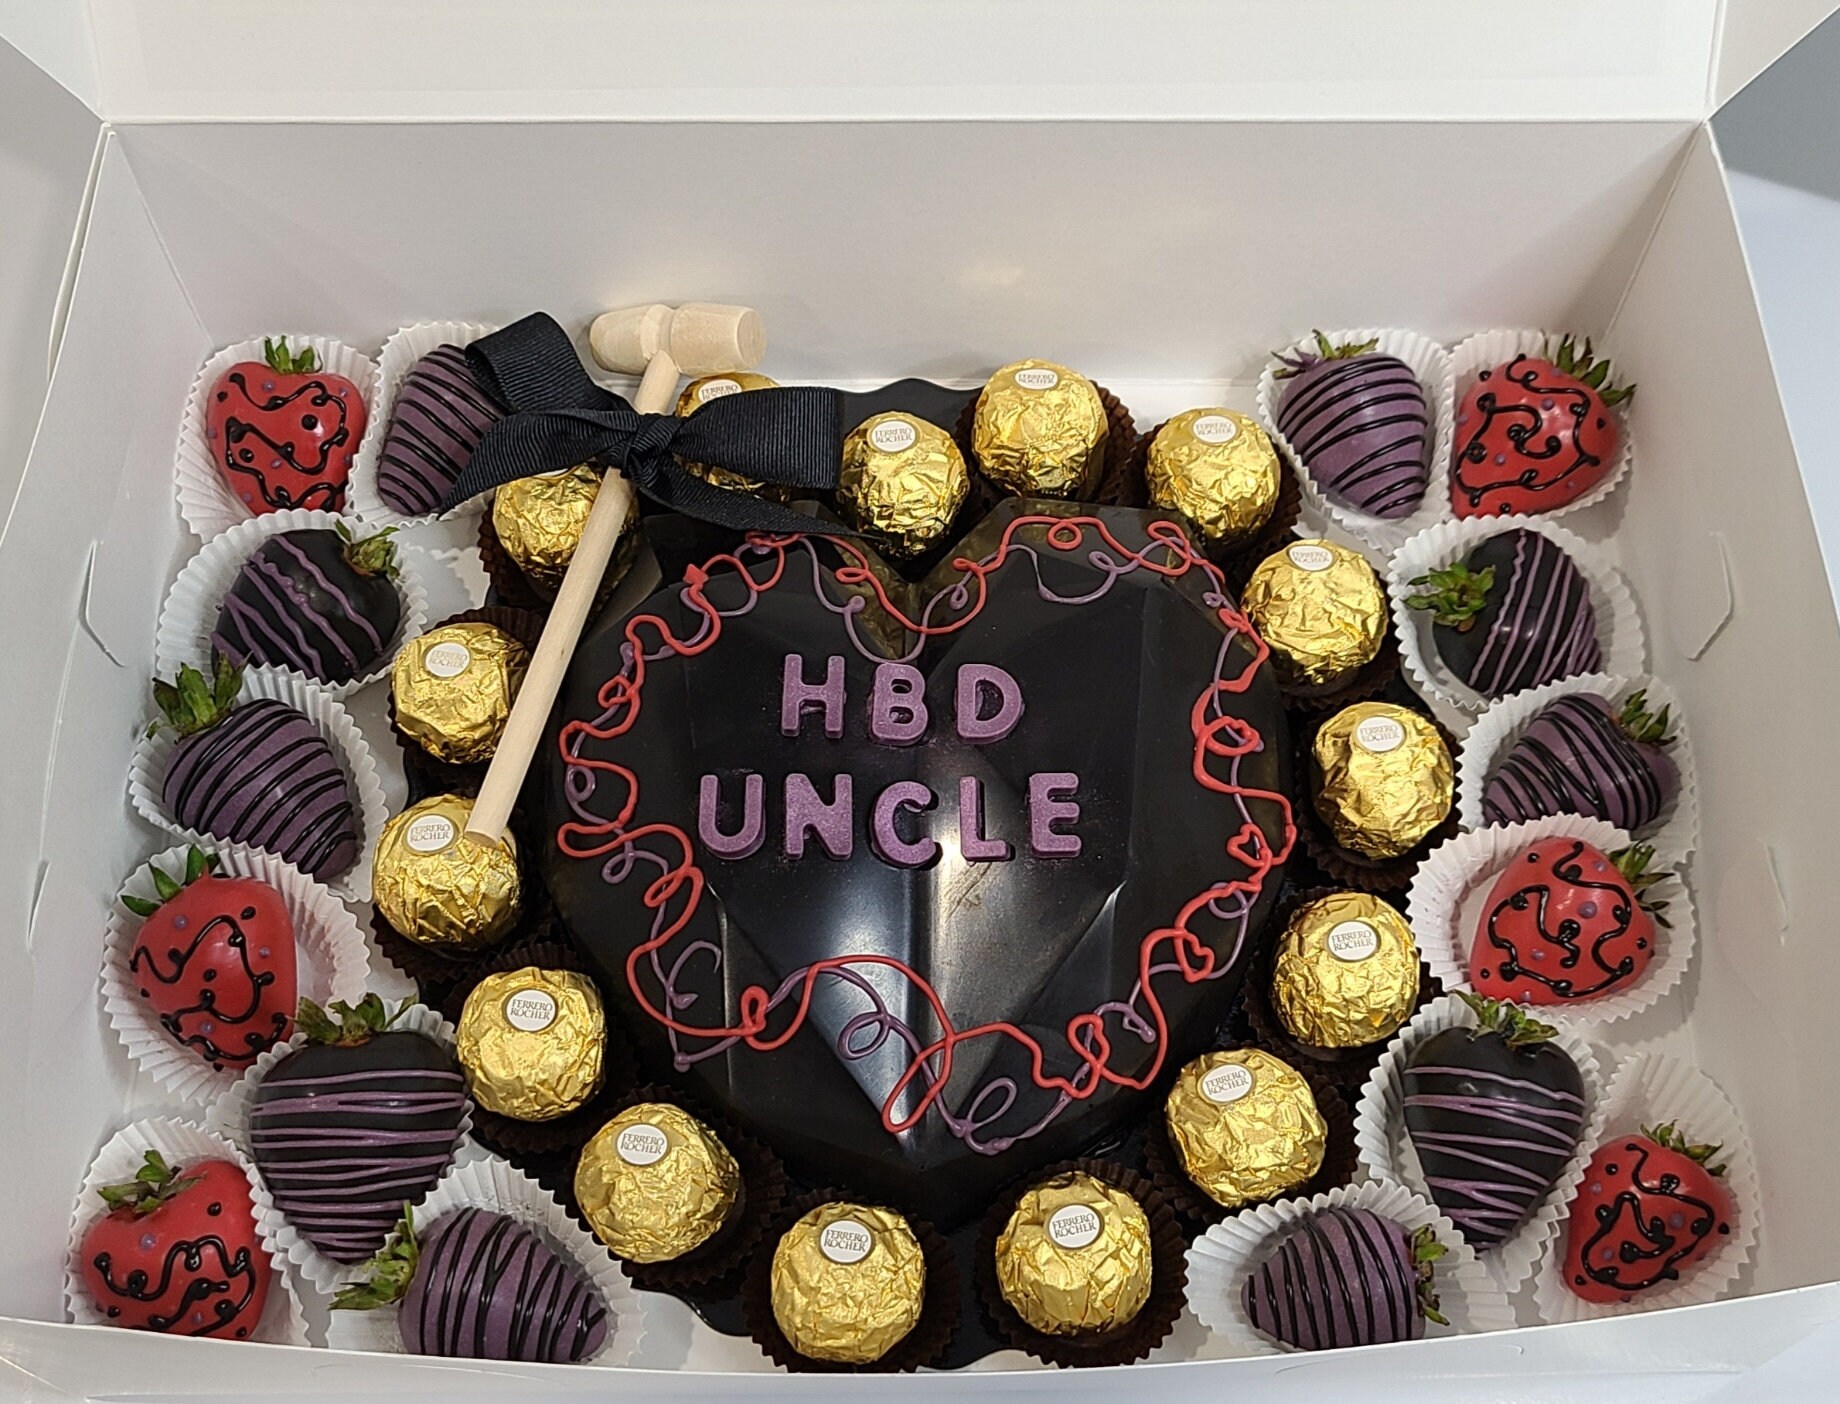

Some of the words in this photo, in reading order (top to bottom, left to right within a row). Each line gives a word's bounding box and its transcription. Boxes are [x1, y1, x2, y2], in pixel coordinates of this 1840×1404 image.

[780, 654, 1025, 746] HBD
[698, 772, 1082, 868] UNCLE
[1332, 930, 1372, 942] FERRERO
[1333, 938, 1374, 951] ROCHER
[511, 999, 553, 1011] FERRERO
[510, 1008, 550, 1020] ROCHER
[1205, 1070, 1247, 1087] FERRERO
[1207, 1079, 1249, 1095] ROCHER
[623, 1133, 665, 1146] FERRERO
[620, 1141, 661, 1154] ROCHER
[1052, 1213, 1095, 1230] FERRERO
[825, 1229, 869, 1243] FERRERO
[1054, 1222, 1097, 1239] ROCHER
[823, 1239, 866, 1252] ROCHER
